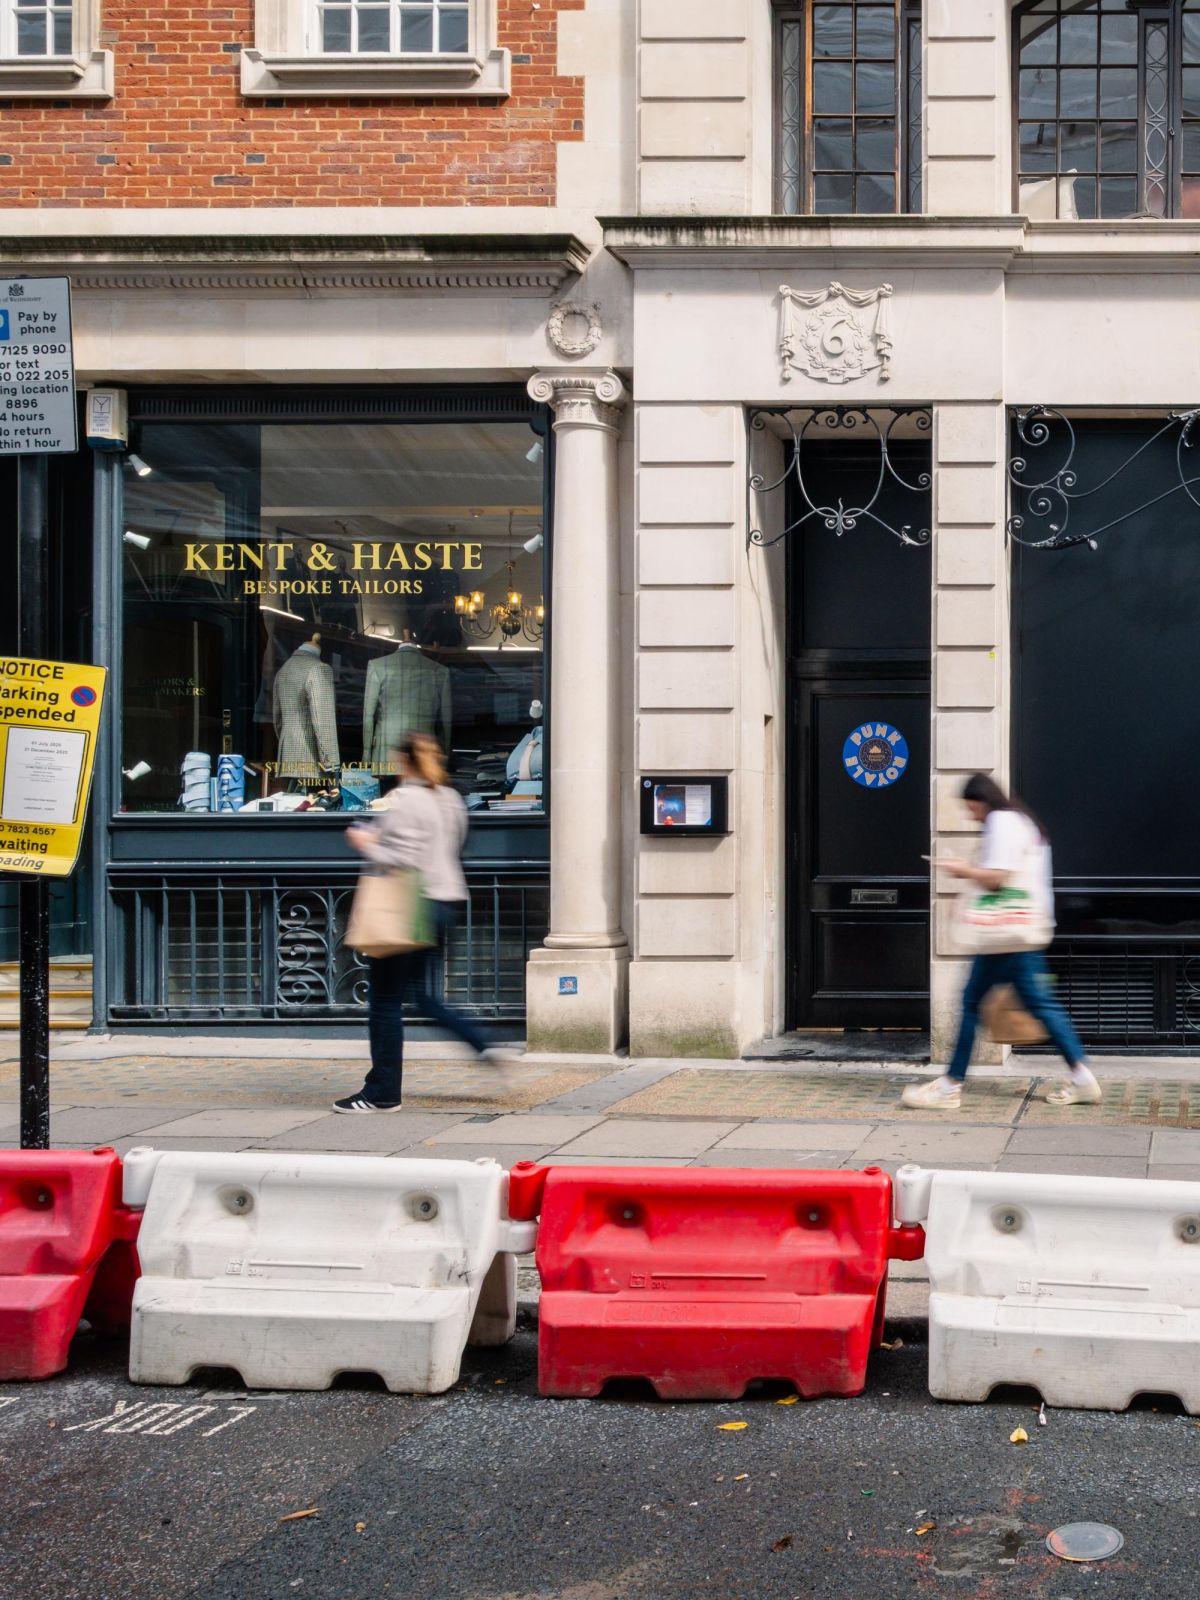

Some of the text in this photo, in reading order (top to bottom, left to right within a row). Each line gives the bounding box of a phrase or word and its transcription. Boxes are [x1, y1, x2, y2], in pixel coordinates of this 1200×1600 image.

[18, 311, 57, 322] Pay by
[20, 324, 56, 336] phone
[822, 319, 847, 356] 6
[0, 344, 67, 356] 7125 9090
[16, 360, 39, 369] text
[16, 371, 40, 381] 022
[44, 370, 69, 380] 205
[22, 384, 69, 394] location
[6, 399, 38, 409] 8896
[12, 412, 45, 422] hours
[14, 427, 51, 436] return
[25, 439, 30, 448] 1
[35, 438, 61, 448] hour
[184, 542, 483, 571] KENT & HASTE
[243, 580, 423, 595] BESPOKE TAILORS
[0, 684, 59, 706] arking
[850, 724, 902, 746] PUNK
[845, 755, 907, 786] ROYALE
[8, 825, 30, 834] 7823
[32, 827, 56, 836] 4567
